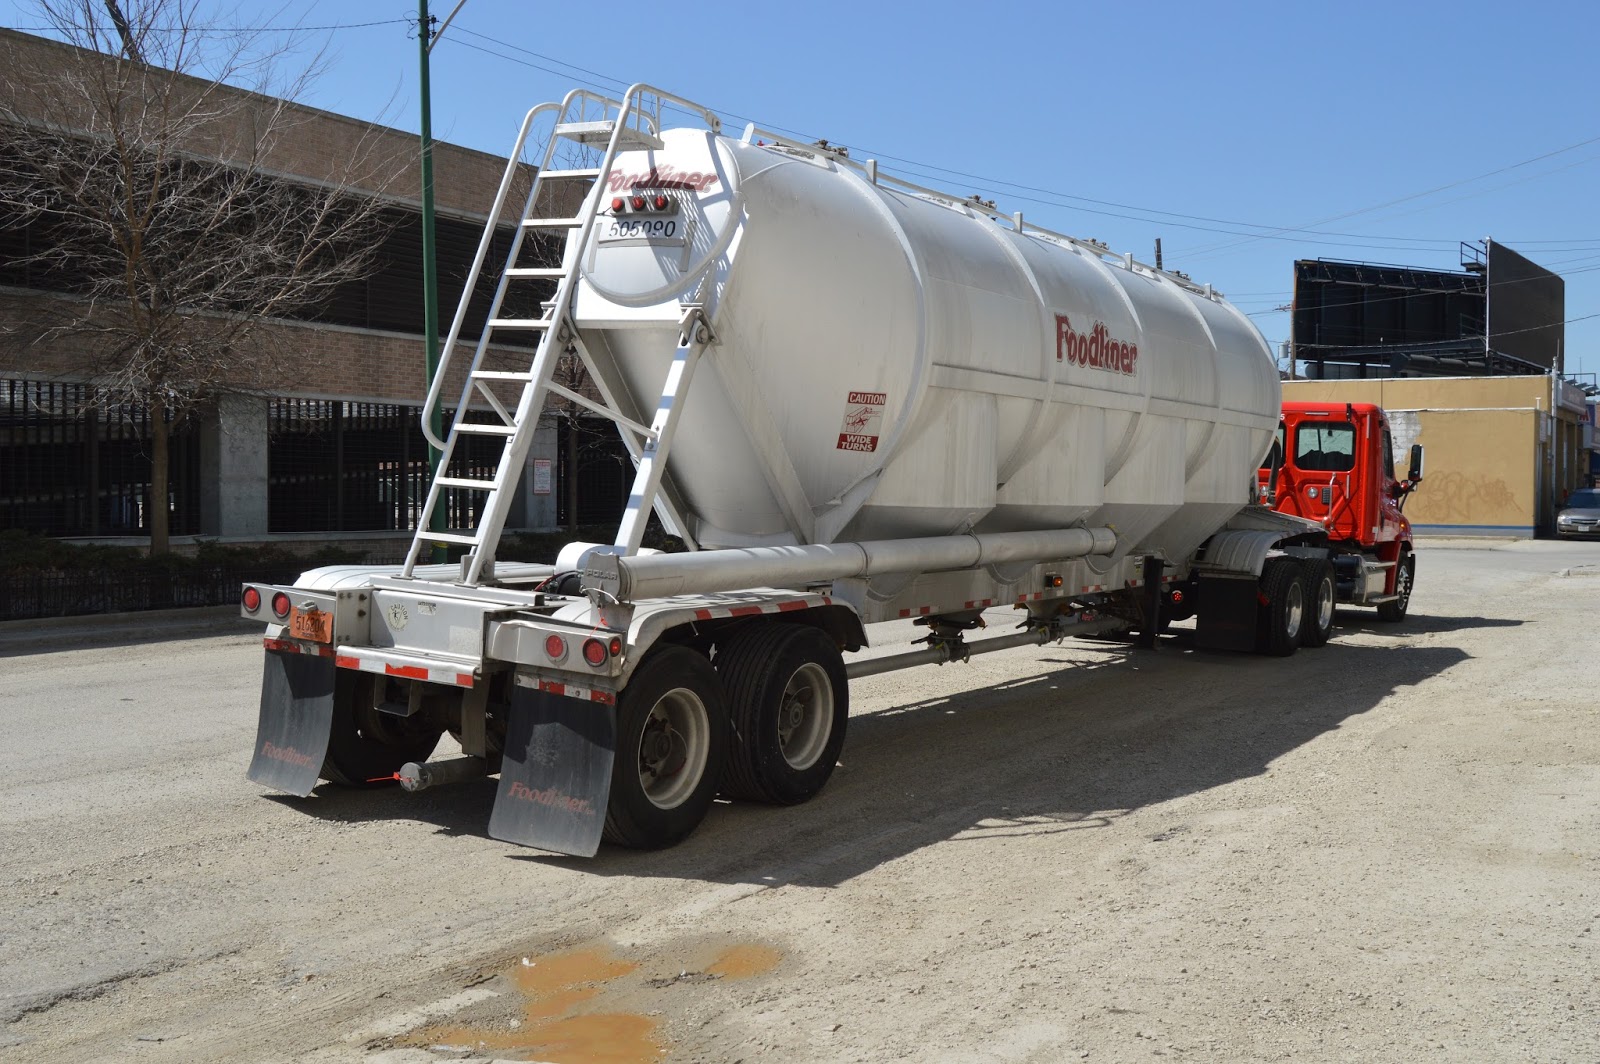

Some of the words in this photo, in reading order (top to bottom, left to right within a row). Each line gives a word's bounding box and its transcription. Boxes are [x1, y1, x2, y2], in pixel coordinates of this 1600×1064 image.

[605, 163, 719, 193] Foodliner
[1054, 312, 1138, 377] Foodliner
[849, 393, 886, 404] CAUTION
[846, 434, 871, 443] WIDE
[841, 441, 873, 451] TURNS
